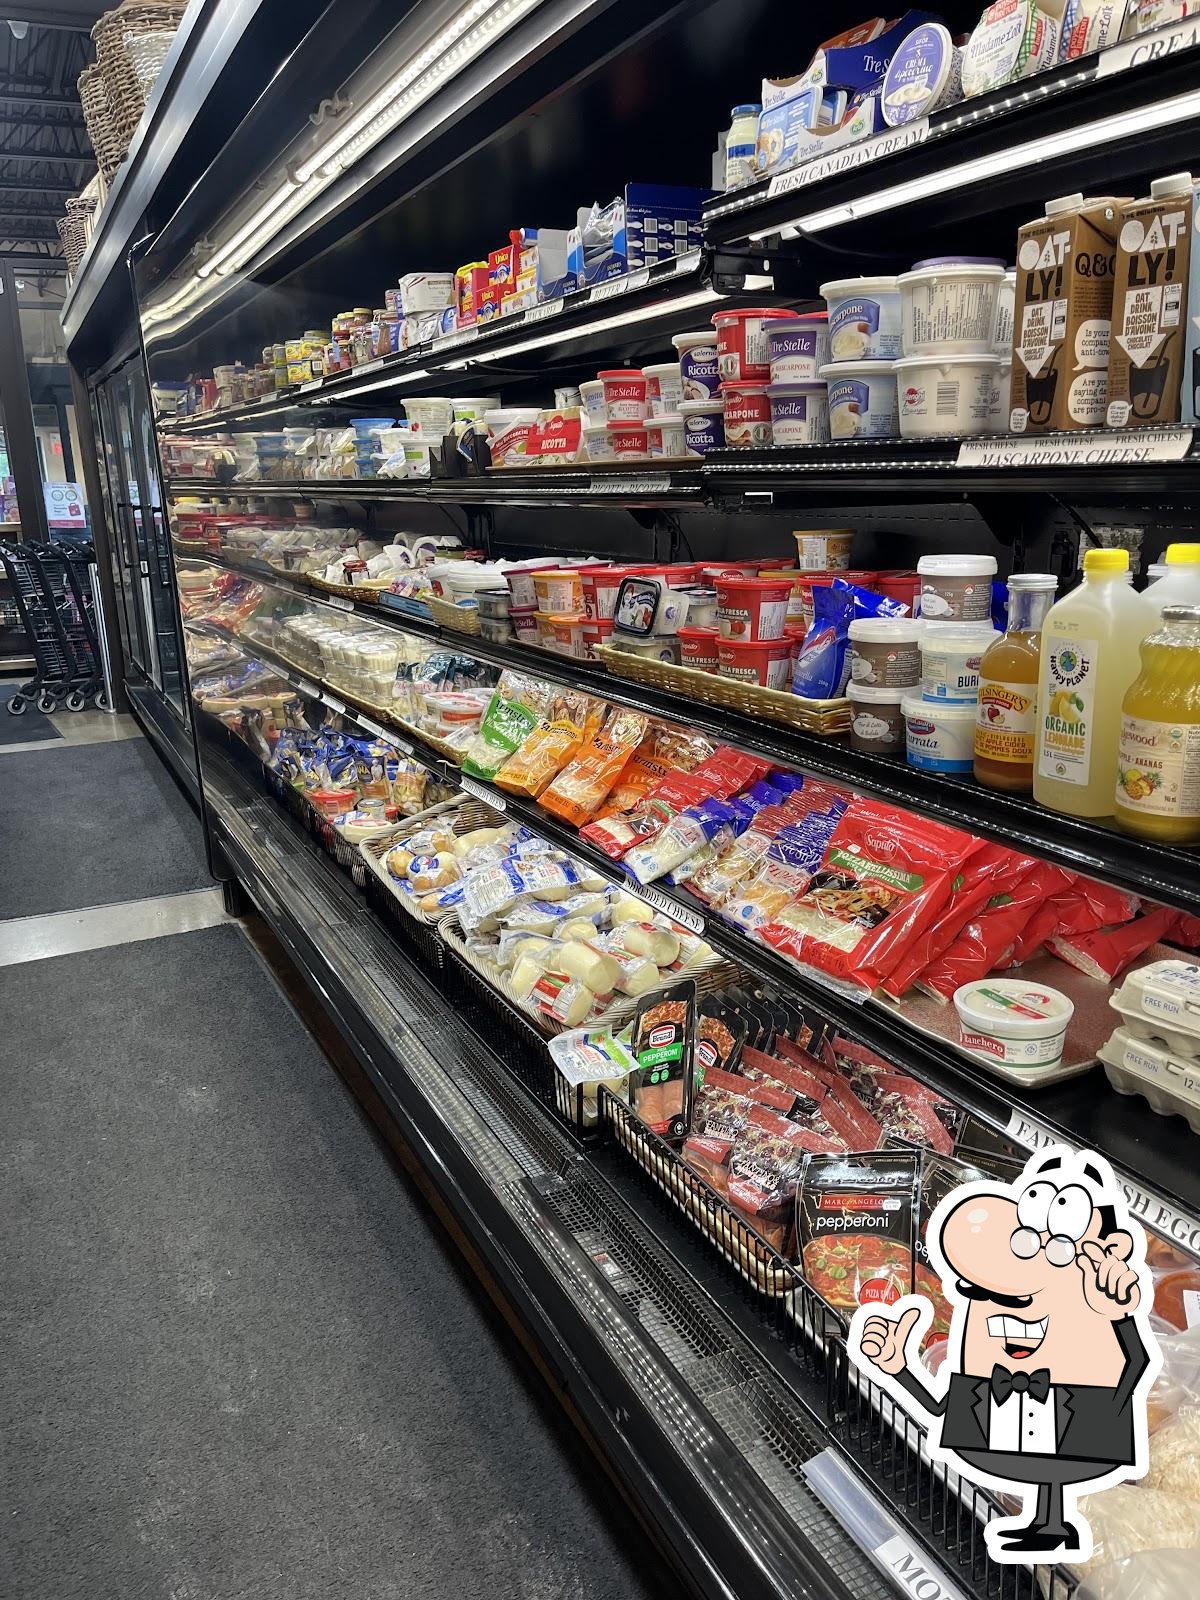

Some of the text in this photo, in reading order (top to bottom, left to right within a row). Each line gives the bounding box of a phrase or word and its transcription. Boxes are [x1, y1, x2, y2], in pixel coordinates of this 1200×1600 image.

[774, 128, 924, 193] FRESH CANADIAN CREAM
[494, 253, 508, 264] Unico
[1128, 248, 1176, 287] LY!
[1026, 267, 1063, 303] LY!
[481, 290, 494, 302] Unico
[1135, 292, 1149, 303] OAT
[1031, 307, 1043, 317] OAT
[1130, 302, 1152, 312] DRINK
[1027, 316, 1045, 327] DRINK
[1126, 312, 1157, 326] BOISSON
[1023, 327, 1048, 338] BOISSON
[1093, 330, 1109, 338] your
[1125, 323, 1156, 336] D'AVOINE
[772, 338, 811, 352] Tre Stelle
[1022, 337, 1047, 348] D'AVOINE
[1126, 335, 1152, 343] CHOCOLATE
[618, 386, 640, 398] Stelle
[1073, 389, 1098, 397] saying
[777, 402, 801, 415] Stelle
[541, 437, 568, 450] RICOTTA
[622, 438, 642, 448] Stelle
[686, 433, 714, 445] Ricotta
[1062, 437, 1095, 446] CHEESE
[1115, 432, 1185, 444] FRESH CHEESE
[966, 440, 1018, 450] FRESH CHEESE
[980, 447, 1155, 466] MASCARPONE CHEESE
[629, 483, 665, 492] RICOTTA
[696, 656, 719, 664] FRESCA
[732, 667, 757, 675] FRESCA
[1045, 716, 1086, 737] ORGANIC
[1044, 731, 1086, 750] LEMONADE
[985, 745, 1010, 754] POMMES
[1135, 757, 1163, 769] ANANAS
[867, 834, 896, 852] Saputo
[625, 878, 702, 931] SHREDDED CHEESE
[1144, 996, 1180, 1015] FREE RUN
[643, 1048, 679, 1064] PEPPERONI
[1126, 1052, 1159, 1073] FREE RUN
[1184, 1077, 1195, 1090] 12
[816, 1213, 889, 1232] pepperoni
[865, 1288, 879, 1298] PIZZA
